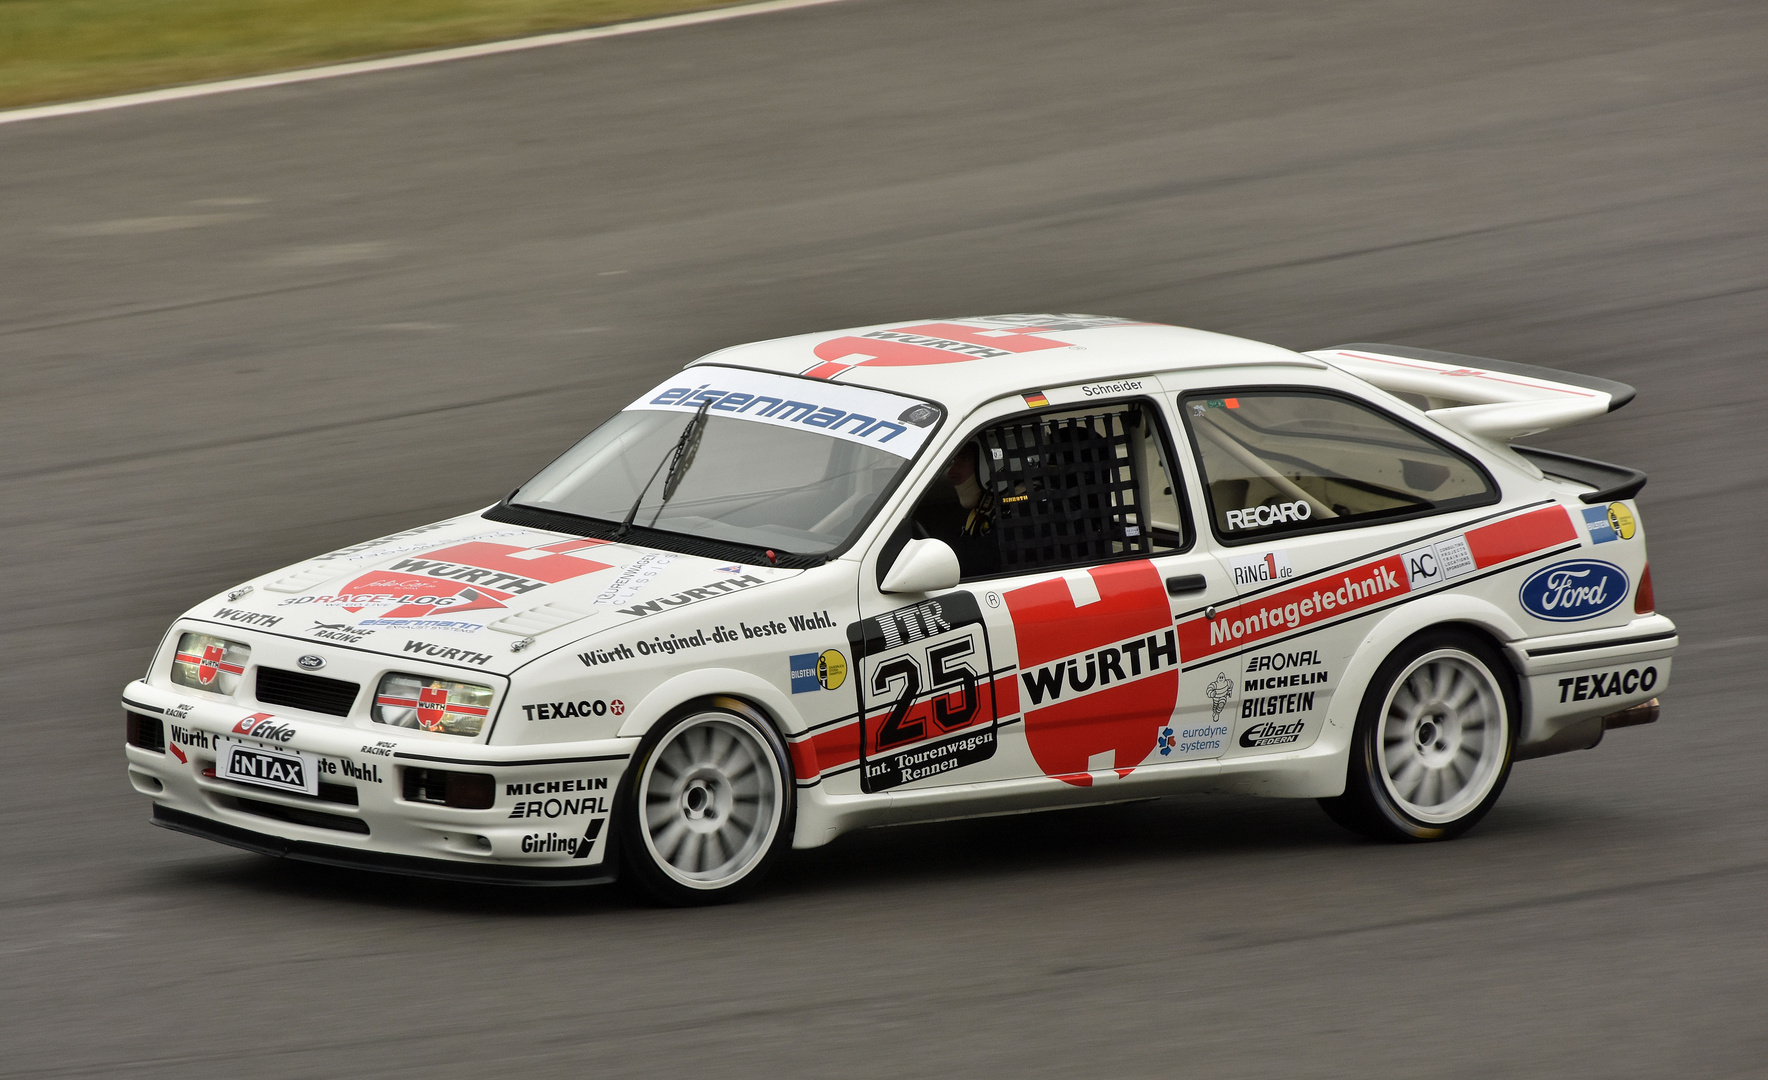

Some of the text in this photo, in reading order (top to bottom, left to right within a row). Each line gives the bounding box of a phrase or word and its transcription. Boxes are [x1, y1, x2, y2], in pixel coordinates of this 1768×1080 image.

[860, 330, 1012, 359] WÜRTH
[1082, 380, 1143, 397] Schneider
[650, 384, 908, 443] eisenmann
[1226, 500, 1312, 530] RECARO
[388, 558, 548, 596] WÜRTH
[593, 553, 661, 604] TOURENWAGEN
[613, 553, 678, 606] CLASSICS
[1410, 553, 1437, 582] AC
[615, 573, 765, 617] WÜRTH
[1542, 569, 1608, 611] Ford
[213, 608, 284, 627] WÜRTH
[1209, 565, 1400, 646] Montagetechnik
[313, 629, 363, 644] RACING
[357, 618, 483, 631] eisenmann
[875, 600, 951, 650] ITR
[577, 610, 837, 667] Würth Original-die beste Wahl.
[402, 640, 494, 666] WÜRTH
[1250, 650, 1322, 672] RONAL
[791, 668, 816, 679] BILSTEIN
[1020, 629, 1178, 706] WÜRTH
[871, 633, 981, 753] 25
[1244, 671, 1328, 692] MICHELIN
[1558, 666, 1657, 703] TEXACO
[165, 708, 188, 719] RACING
[522, 699, 607, 721] TEXACO
[1241, 691, 1315, 718] BILSTEIN
[171, 724, 209, 749] Würth
[251, 720, 296, 742] Enke
[1182, 725, 1228, 738] eurodyne
[1239, 719, 1305, 746] Eibach
[1254, 735, 1296, 747] FEDERN
[361, 746, 392, 757] RACING
[864, 732, 994, 778] Int. Tourenwagen
[1180, 739, 1220, 752] systems
[340, 759, 383, 783] Wahl.
[901, 757, 959, 783] Rennen
[506, 777, 608, 796] MICHELIN
[512, 797, 608, 819] RONAL
[521, 832, 577, 855] Girling
